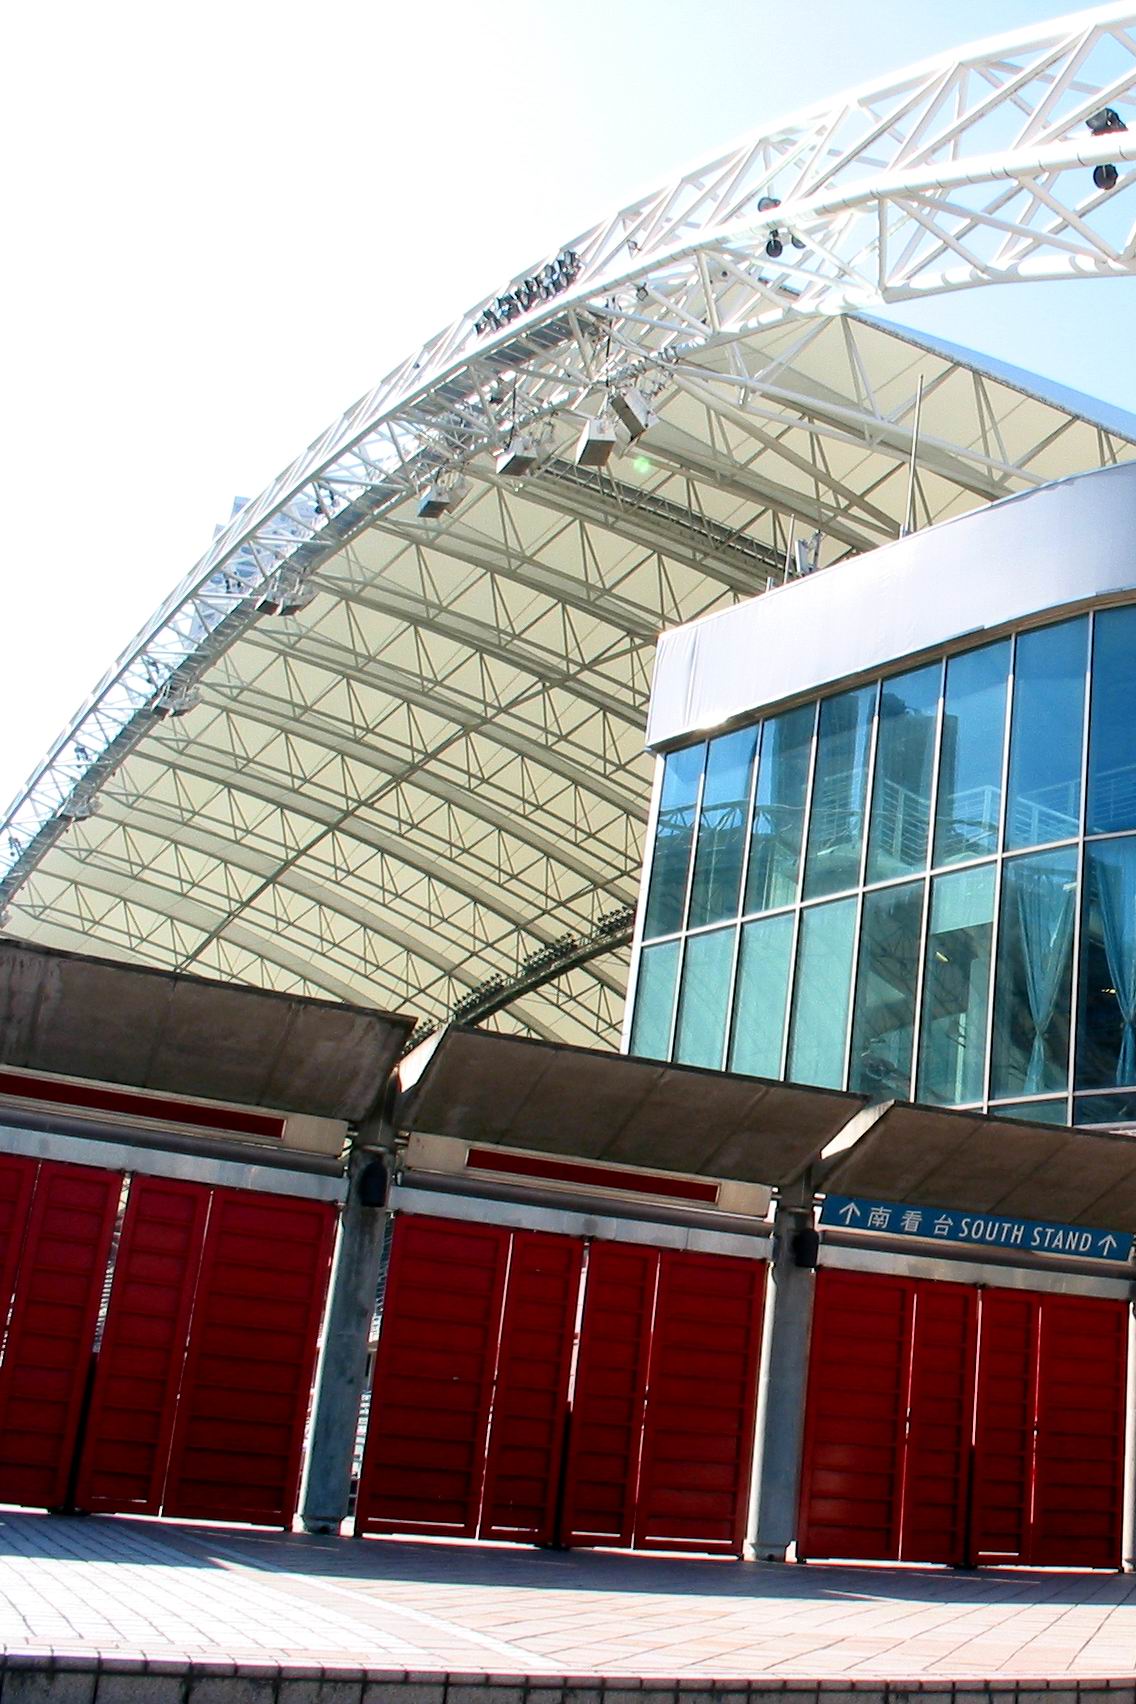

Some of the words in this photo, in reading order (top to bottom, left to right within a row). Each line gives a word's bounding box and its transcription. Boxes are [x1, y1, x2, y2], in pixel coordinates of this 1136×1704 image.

[867, 1206, 954, 1236] 南看台
[958, 1217, 1024, 1244] SOUTH
[1031, 1226, 1092, 1252] STAND
